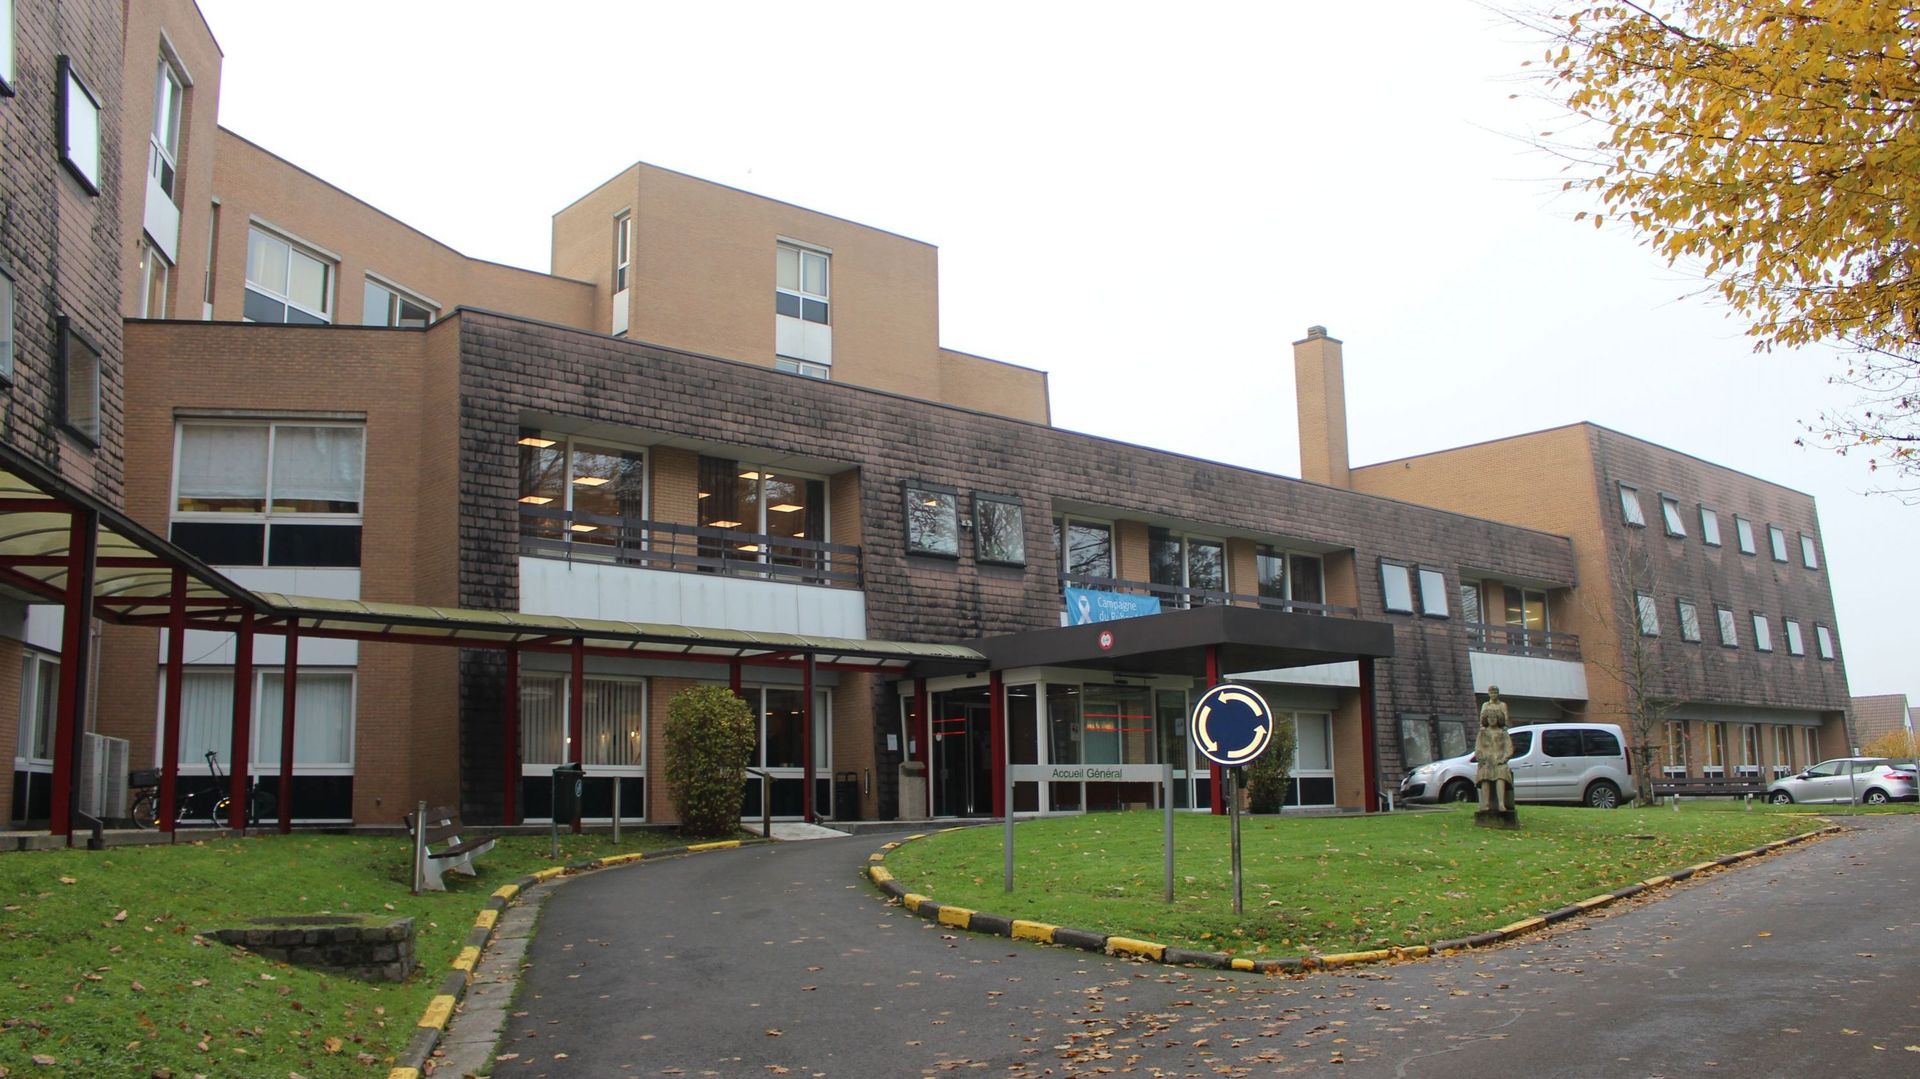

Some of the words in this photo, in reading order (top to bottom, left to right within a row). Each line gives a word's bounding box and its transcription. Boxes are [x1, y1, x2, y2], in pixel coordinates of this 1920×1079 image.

[1097, 596, 1137, 612] Campagne
[1052, 768, 1084, 778] Accueil
[1086, 768, 1123, 779] Général
